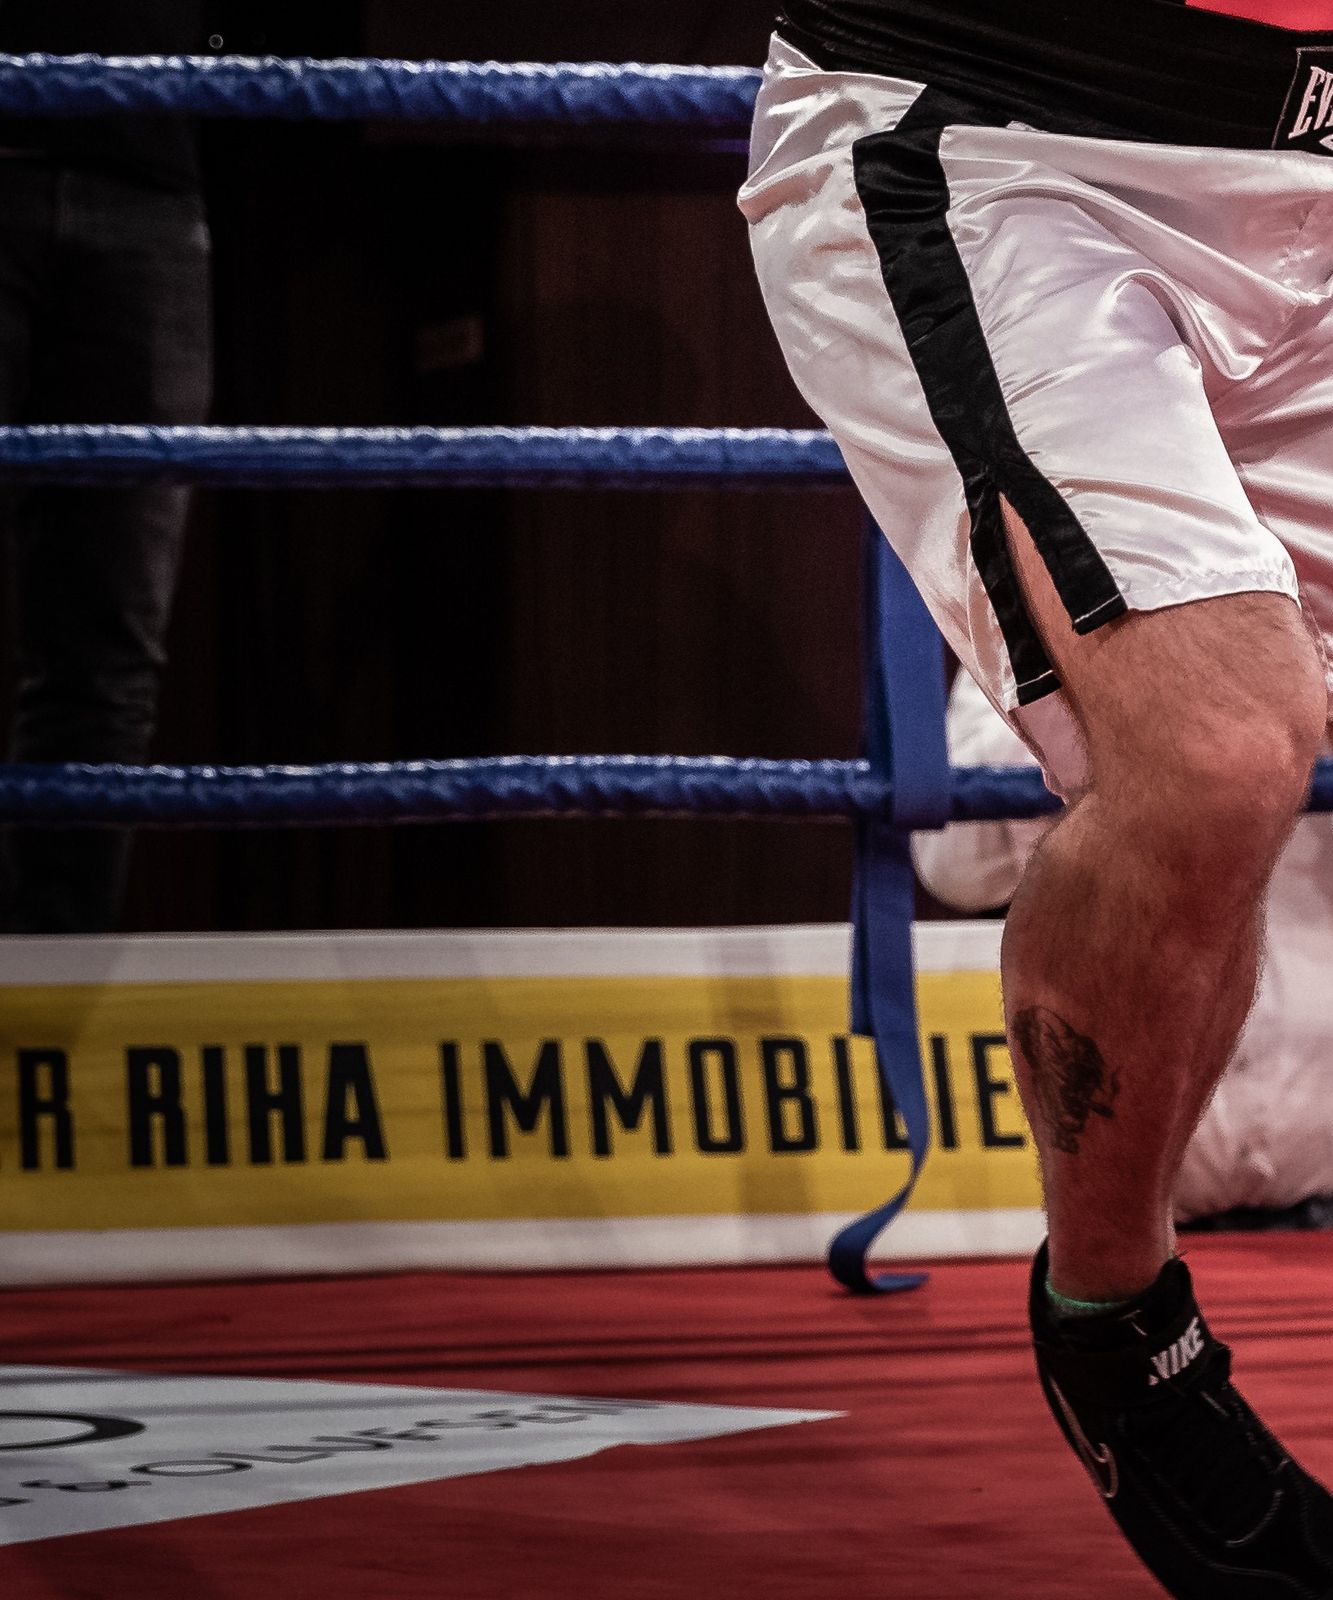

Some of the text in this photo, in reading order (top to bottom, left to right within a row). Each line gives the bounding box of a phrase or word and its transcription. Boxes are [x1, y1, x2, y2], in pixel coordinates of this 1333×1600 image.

[17, 1032, 1026, 1171] R RIHA IMMOBILIE
